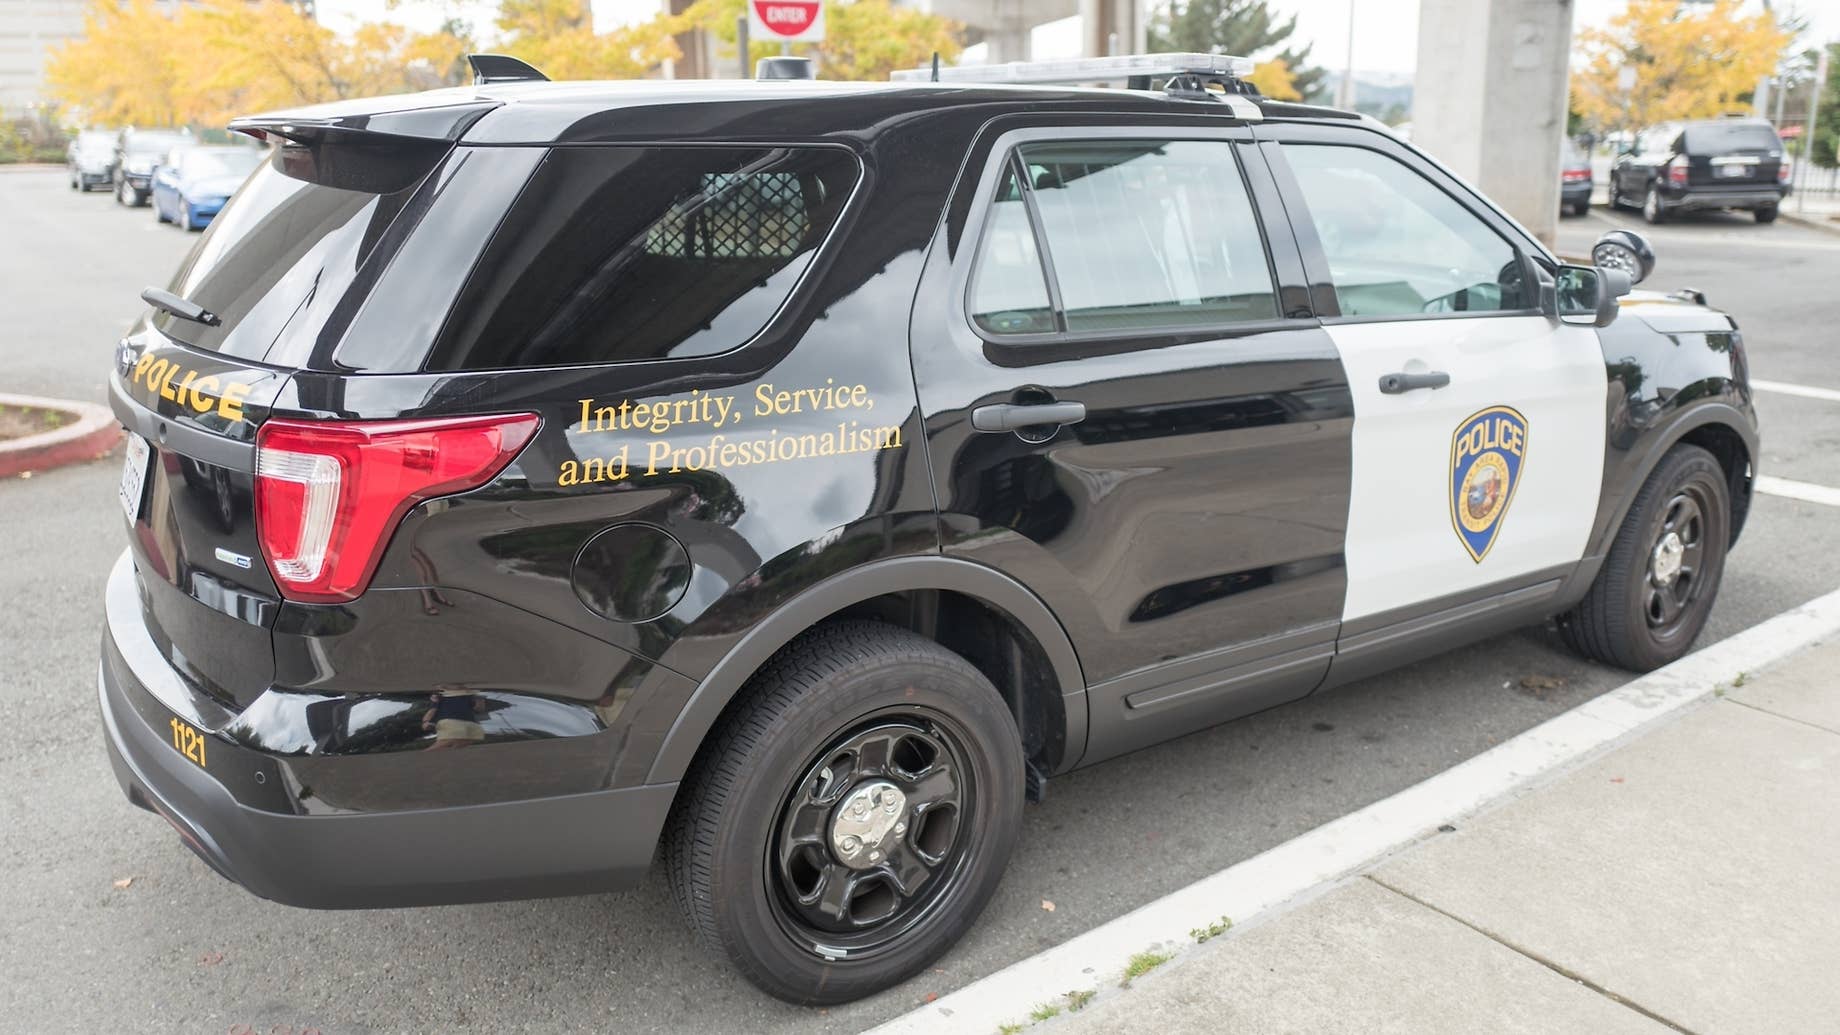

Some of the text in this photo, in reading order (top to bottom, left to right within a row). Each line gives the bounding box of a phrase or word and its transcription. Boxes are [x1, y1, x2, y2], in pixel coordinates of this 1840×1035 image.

[766, 6, 807, 24] ENTER
[134, 352, 252, 422] POLICE
[575, 378, 875, 435] Integrity, Service,
[558, 421, 903, 487] and Professionalism
[1456, 417, 1523, 468] POLICE
[170, 717, 206, 768] 1121
